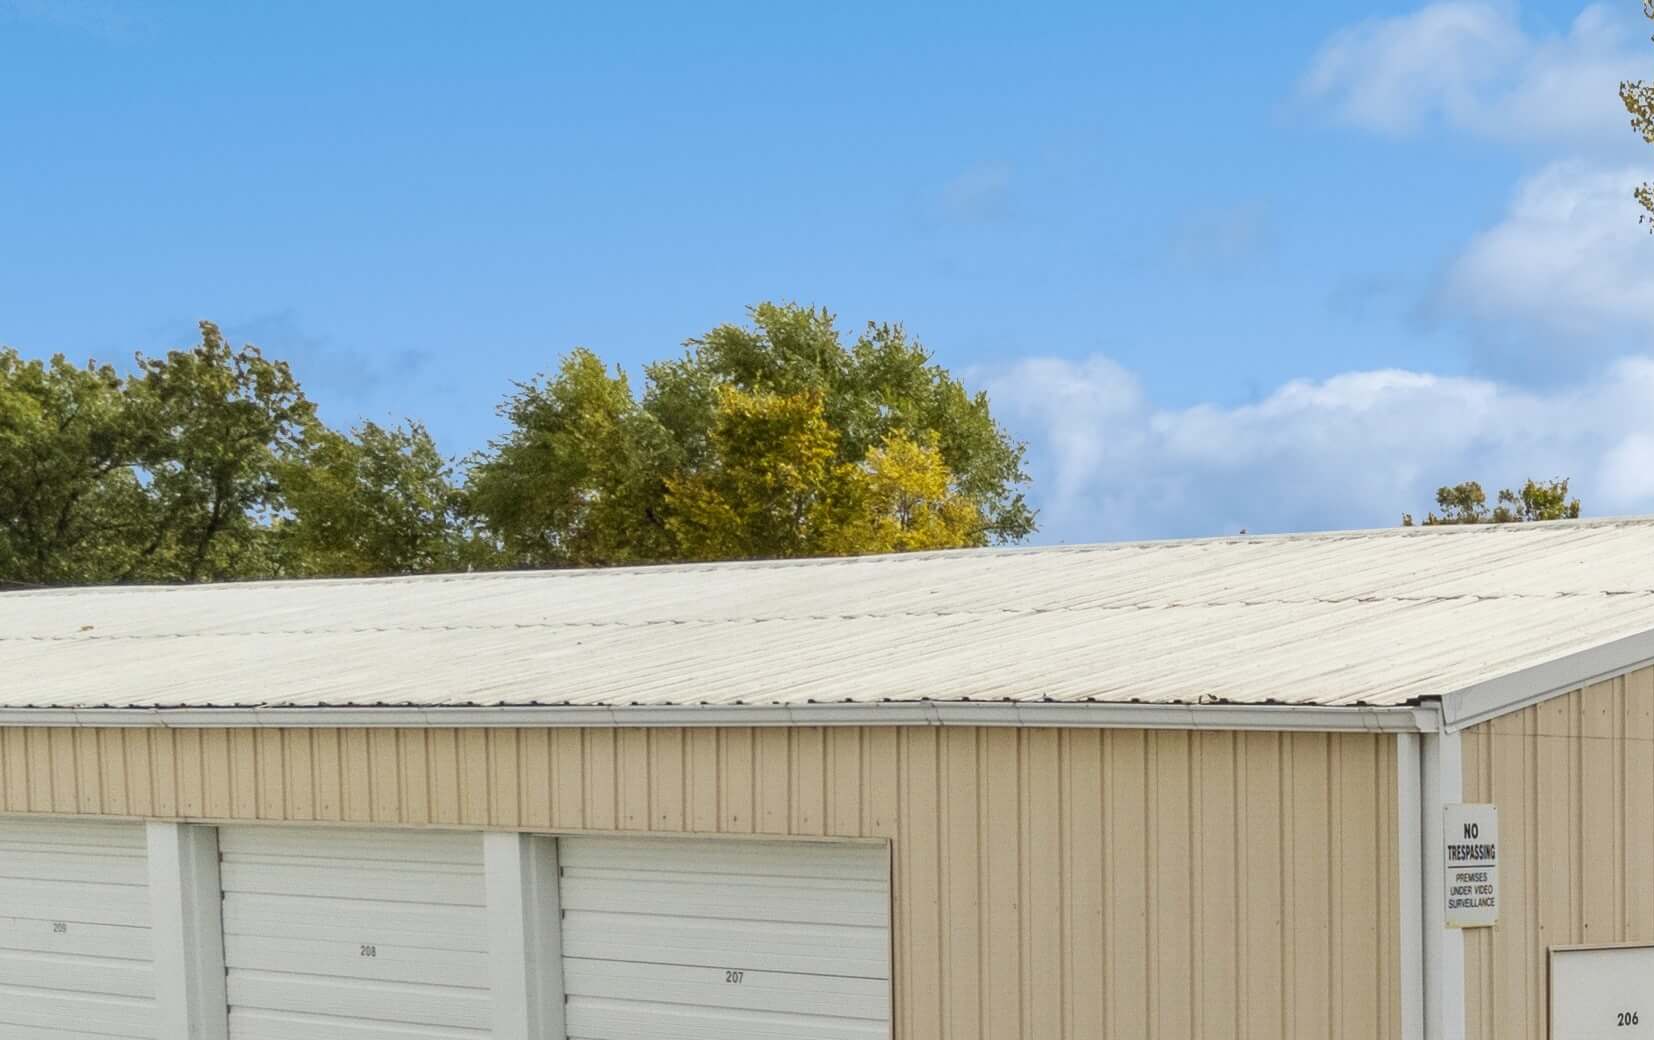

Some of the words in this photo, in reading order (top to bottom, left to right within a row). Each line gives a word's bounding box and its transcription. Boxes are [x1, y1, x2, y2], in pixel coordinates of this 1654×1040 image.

[1463, 823, 1479, 839] NO
[1447, 843, 1496, 862] TRESPASSING
[1455, 872, 1488, 883] PREMISES
[1450, 886, 1473, 897] UNDER
[1475, 884, 1494, 895] VIDEO
[1448, 897, 1496, 909] SURVEILLANCE
[725, 970, 744, 984] 207
[1617, 1010, 1639, 1027] 206
